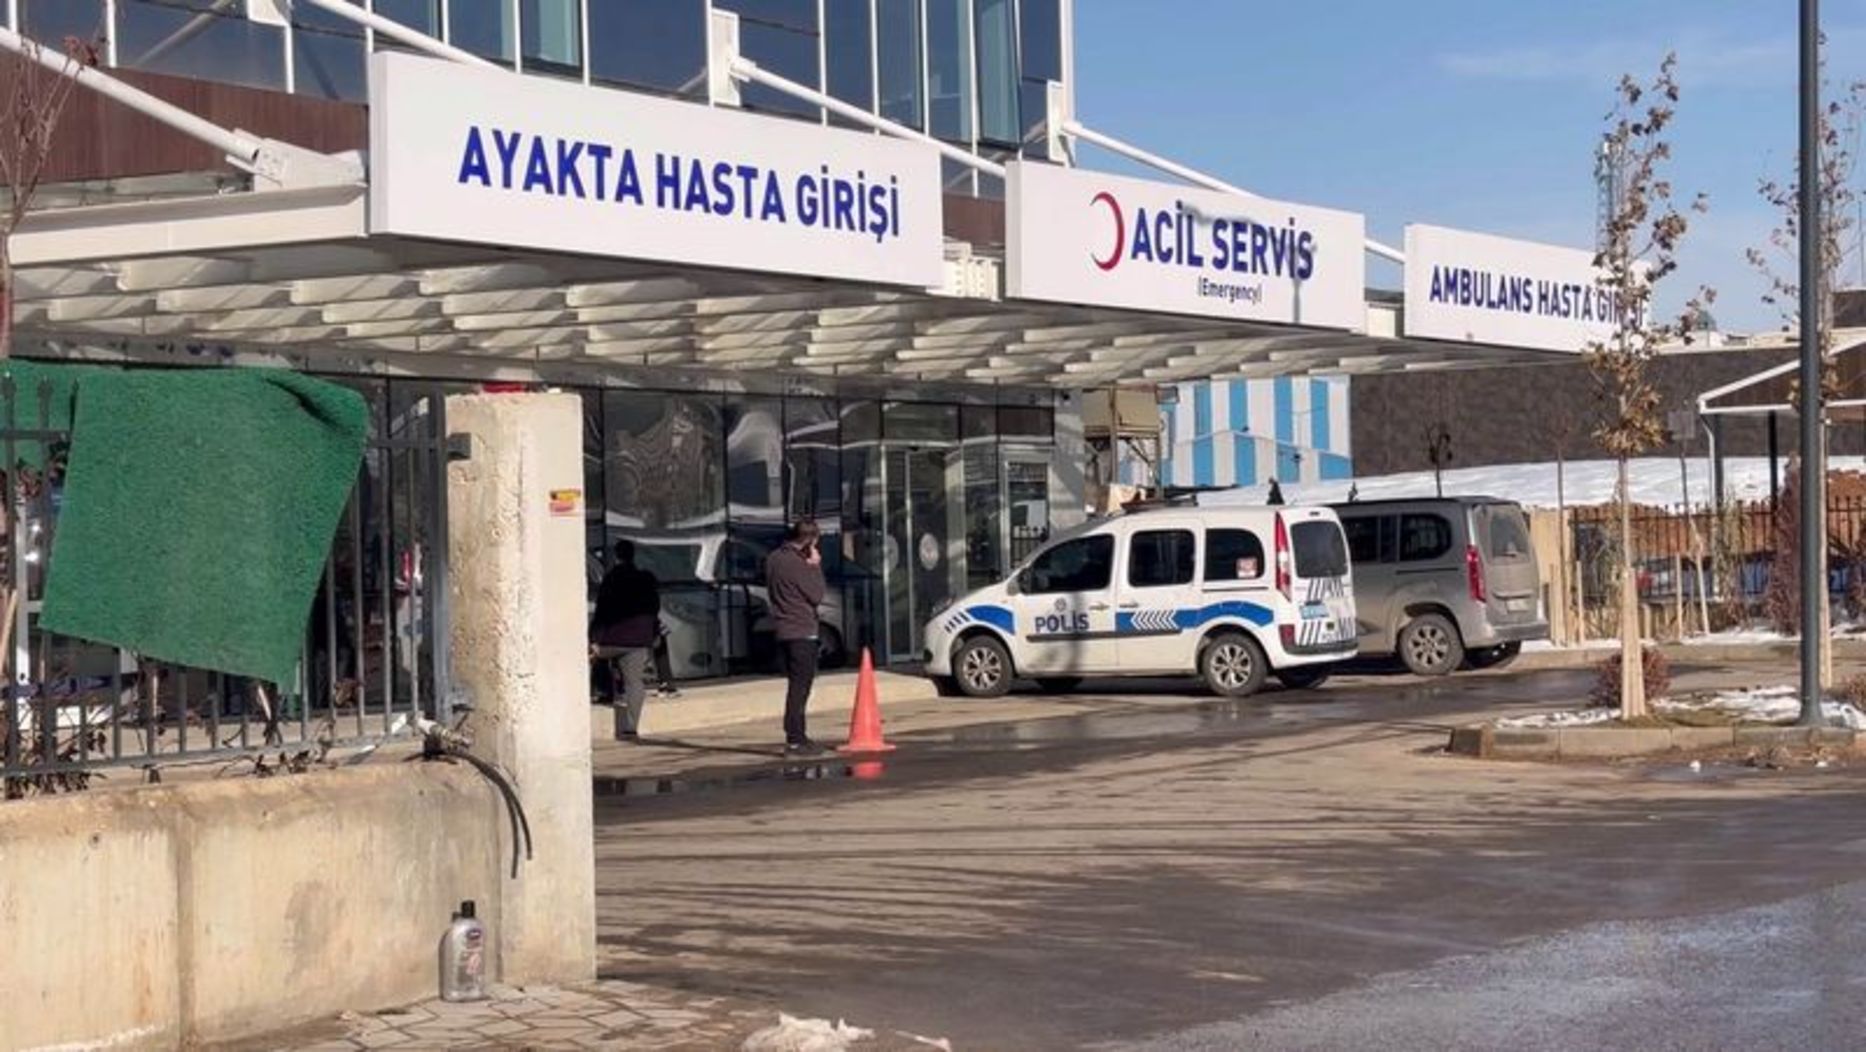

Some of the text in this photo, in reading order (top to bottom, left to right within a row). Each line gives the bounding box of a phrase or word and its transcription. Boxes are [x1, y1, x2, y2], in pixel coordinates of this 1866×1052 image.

[458, 126, 900, 244] AYAKTA HASTA GİRİŞİ
[1131, 199, 1315, 281] ACİL SERVİS
[1198, 275, 1262, 305] (Emergency)
[1430, 265, 1533, 315] AMBULANS
[1537, 279, 1594, 322] HASTA
[1034, 609, 1090, 634] POLİS
